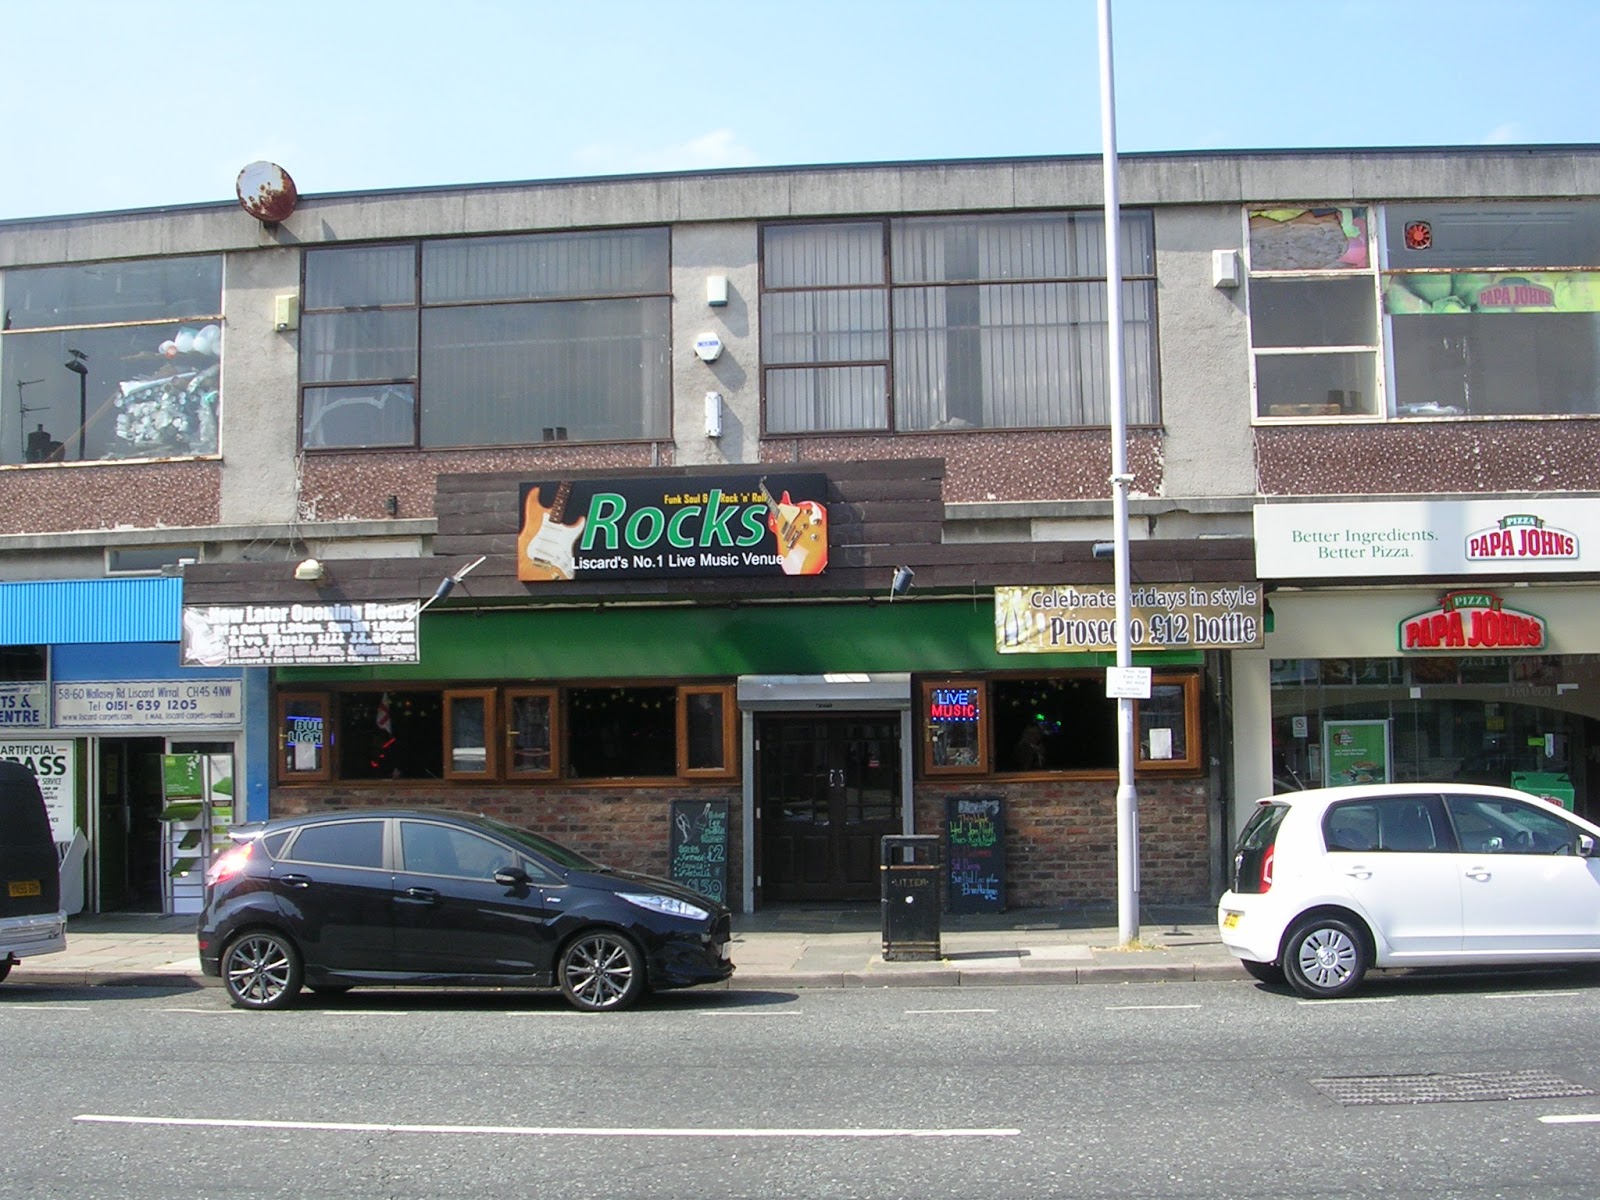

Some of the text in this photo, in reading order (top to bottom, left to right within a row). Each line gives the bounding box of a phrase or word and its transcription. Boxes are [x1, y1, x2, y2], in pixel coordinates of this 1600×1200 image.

[1480, 286, 1511, 305] PAPA
[664, 494, 682, 504] Funk
[683, 493, 701, 504] Soul
[702, 493, 708, 503] &
[720, 492, 738, 503] Rock
[752, 492, 768, 502] Roll
[580, 489, 767, 551] Rocks
[1505, 516, 1536, 525] PIZZA
[1292, 528, 1439, 544] Better Ingredients.
[1470, 532, 1515, 557] PAPA
[1318, 545, 1414, 559] Better Pizza.
[571, 552, 785, 570] Liscard's No.1 Live Music Venue
[1031, 587, 1256, 611] Celebrate ridays in style
[1454, 595, 1491, 607] PIZZA
[246, 606, 289, 622] Later
[291, 604, 362, 623] Opening
[1050, 612, 1256, 645] Proseco £12 bottle
[1406, 612, 1465, 648] PAPA
[267, 633, 314, 646] Music
[226, 656, 272, 665] Liscard's
[58, 688, 84, 700] 58-60
[86, 687, 115, 700] Wallasey
[116, 687, 126, 699] Rd
[128, 687, 155, 698] Liscard
[157, 686, 179, 697] Wirral
[212, 686, 232, 697] 4NW
[938, 692, 968, 705] LIVE
[21, 694, 31, 708] &
[167, 699, 198, 710] 1205
[931, 704, 975, 718] MUSIC
[1, 745, 56, 755] ARTIFICIAL
[895, 878, 927, 887] LITTER
